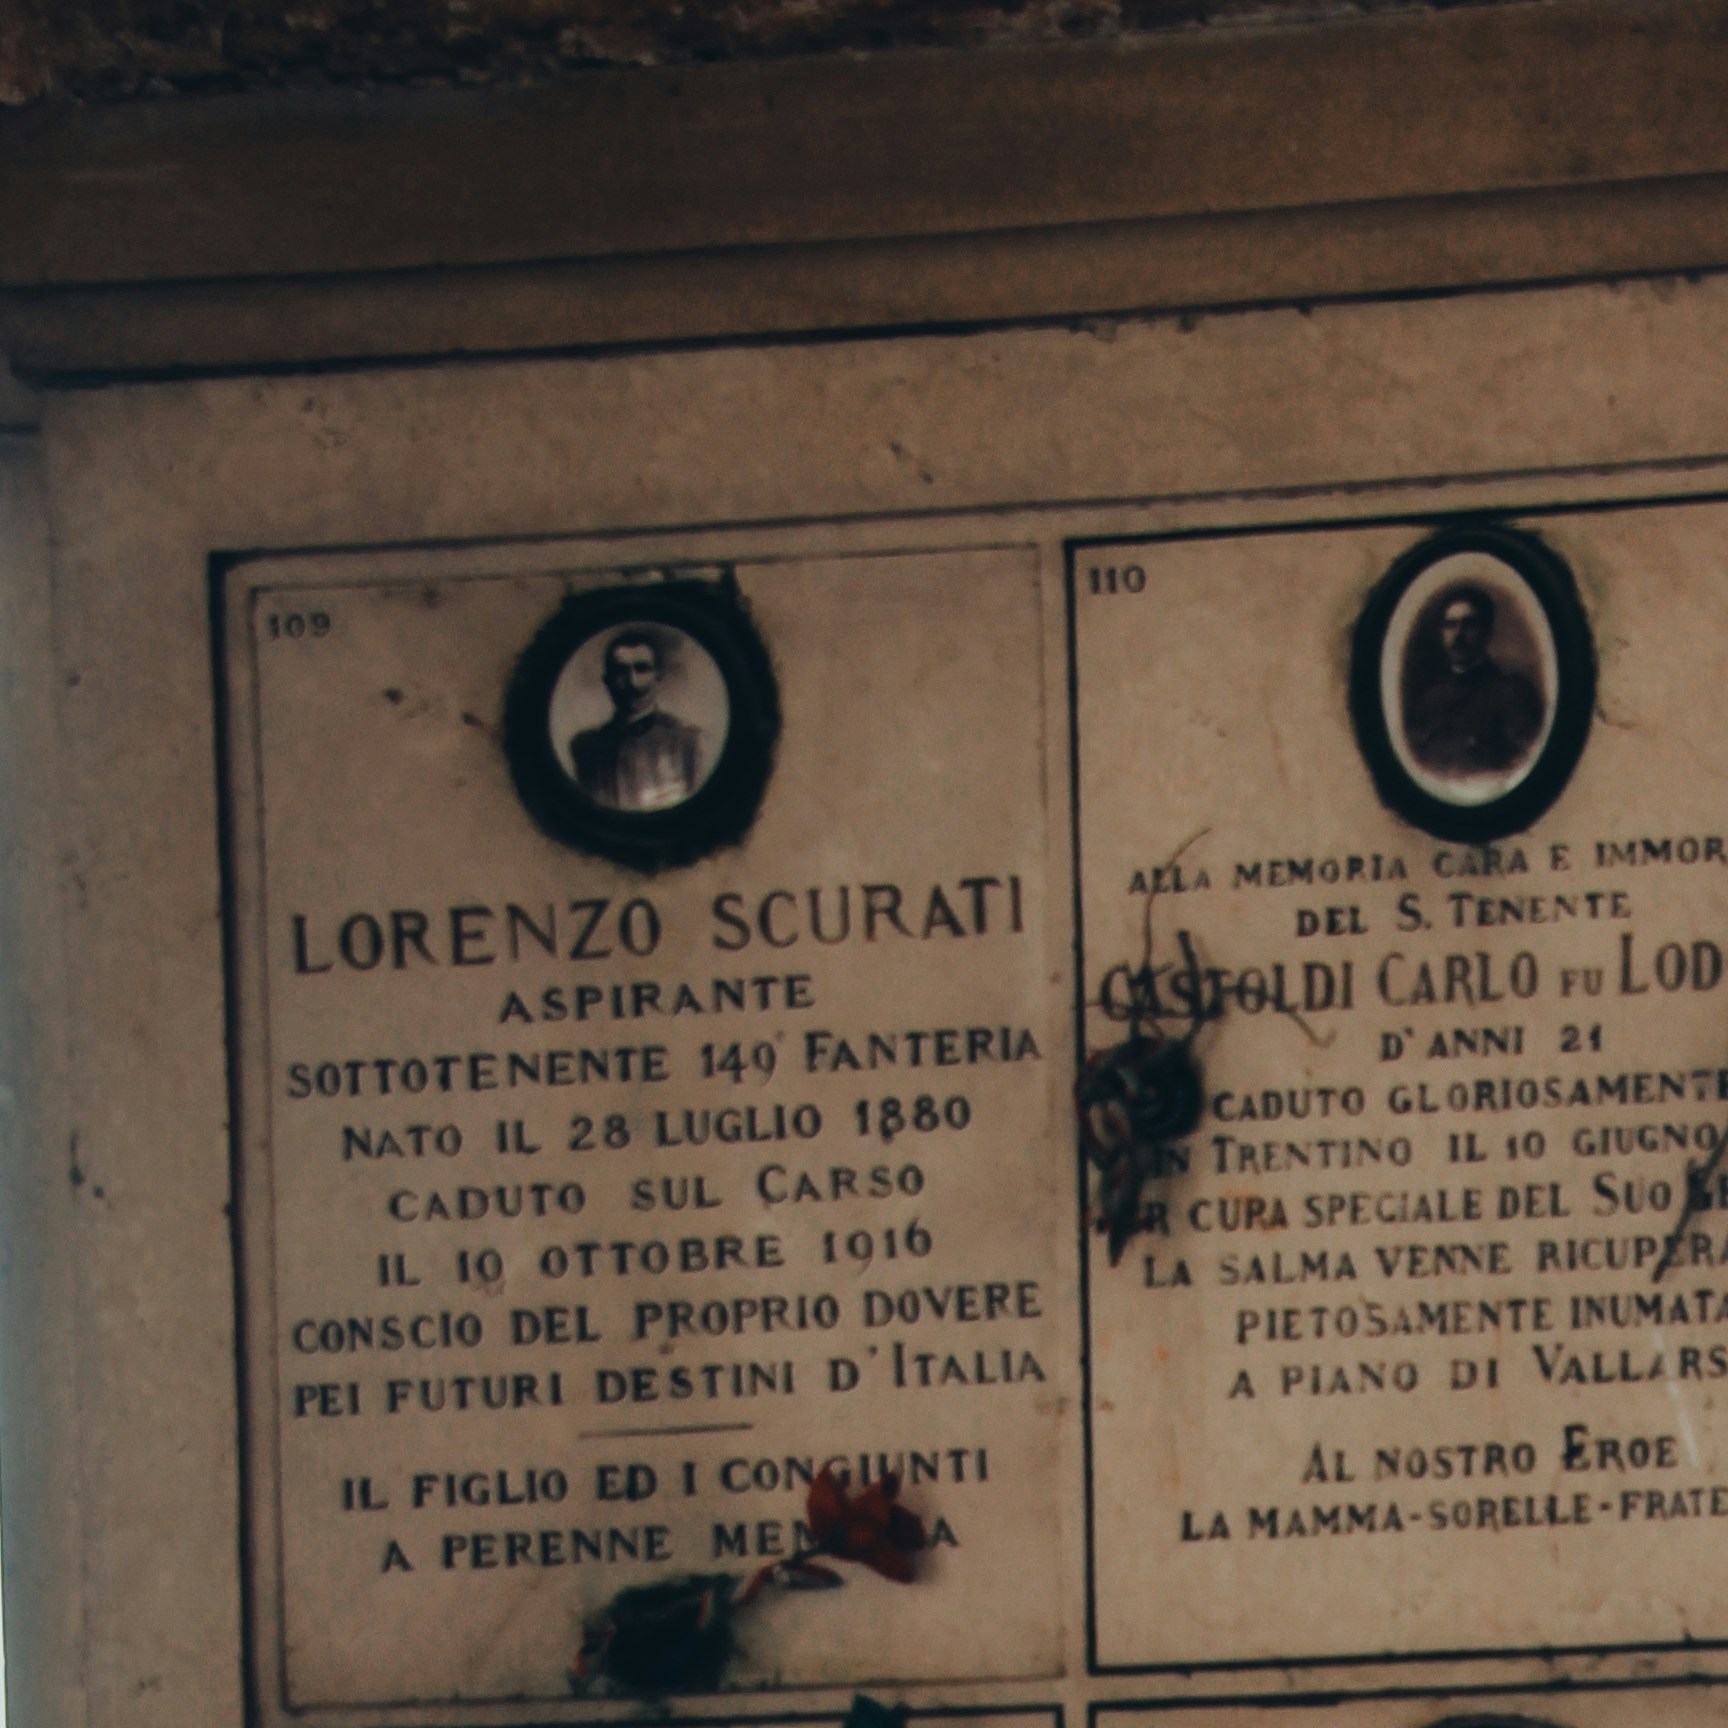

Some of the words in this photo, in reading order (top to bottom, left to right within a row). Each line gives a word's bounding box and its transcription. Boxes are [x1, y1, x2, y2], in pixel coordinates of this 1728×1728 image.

[1089, 566, 1145, 594] 110
[269, 612, 330, 638] 109
[1234, 854, 1407, 888] MEMORIA
[1433, 849, 1528, 877] CARA
[1550, 844, 1568, 870] E
[292, 897, 662, 974] LORENZO
[711, 875, 1023, 951] SCURATI
[1297, 906, 1366, 937] DEL
[1448, 891, 1630, 927] TENENTE
[499, 974, 813, 1023] ASPIRANTE
[1377, 951, 1538, 1005] CARLO
[1561, 969, 1602, 997] FU
[288, 1045, 668, 1098] SOTTOTENENTE
[805, 1026, 1039, 1072] FANTERIA
[342, 1124, 462, 1161] NATO
[497, 1120, 539, 1155] IL
[569, 1114, 630, 1151] 28
[655, 1104, 822, 1146] LUGLIO
[855, 1095, 971, 1143] 1880
[388, 1182, 585, 1221] CADUTO
[632, 1176, 721, 1210] SUL
[756, 1164, 924, 1207] CARSO
[378, 1254, 419, 1286] IL
[458, 1250, 502, 1283] 10
[539, 1235, 784, 1277] OTTOBRE
[823, 1218, 932, 1274] 1916
[1144, 1255, 1192, 1287] LA
[1220, 1251, 1357, 1285] SALMA
[1375, 1242, 1510, 1277] VENNE
[292, 1311, 482, 1353] CONSCIO
[511, 1306, 599, 1345] DEL
[634, 1294, 839, 1340] PROPRIO
[864, 1281, 1041, 1327] DOVERE
[1236, 1297, 1551, 1345] PIETOSAMENTE
[1229, 1370, 1255, 1398] A
[1281, 1362, 1418, 1396] PIANO
[1451, 1358, 1498, 1390] DI
[1303, 1443, 1354, 1483] AL
[1376, 1443, 1536, 1478] NOSTRO
[1561, 1423, 1676, 1471] EROE
